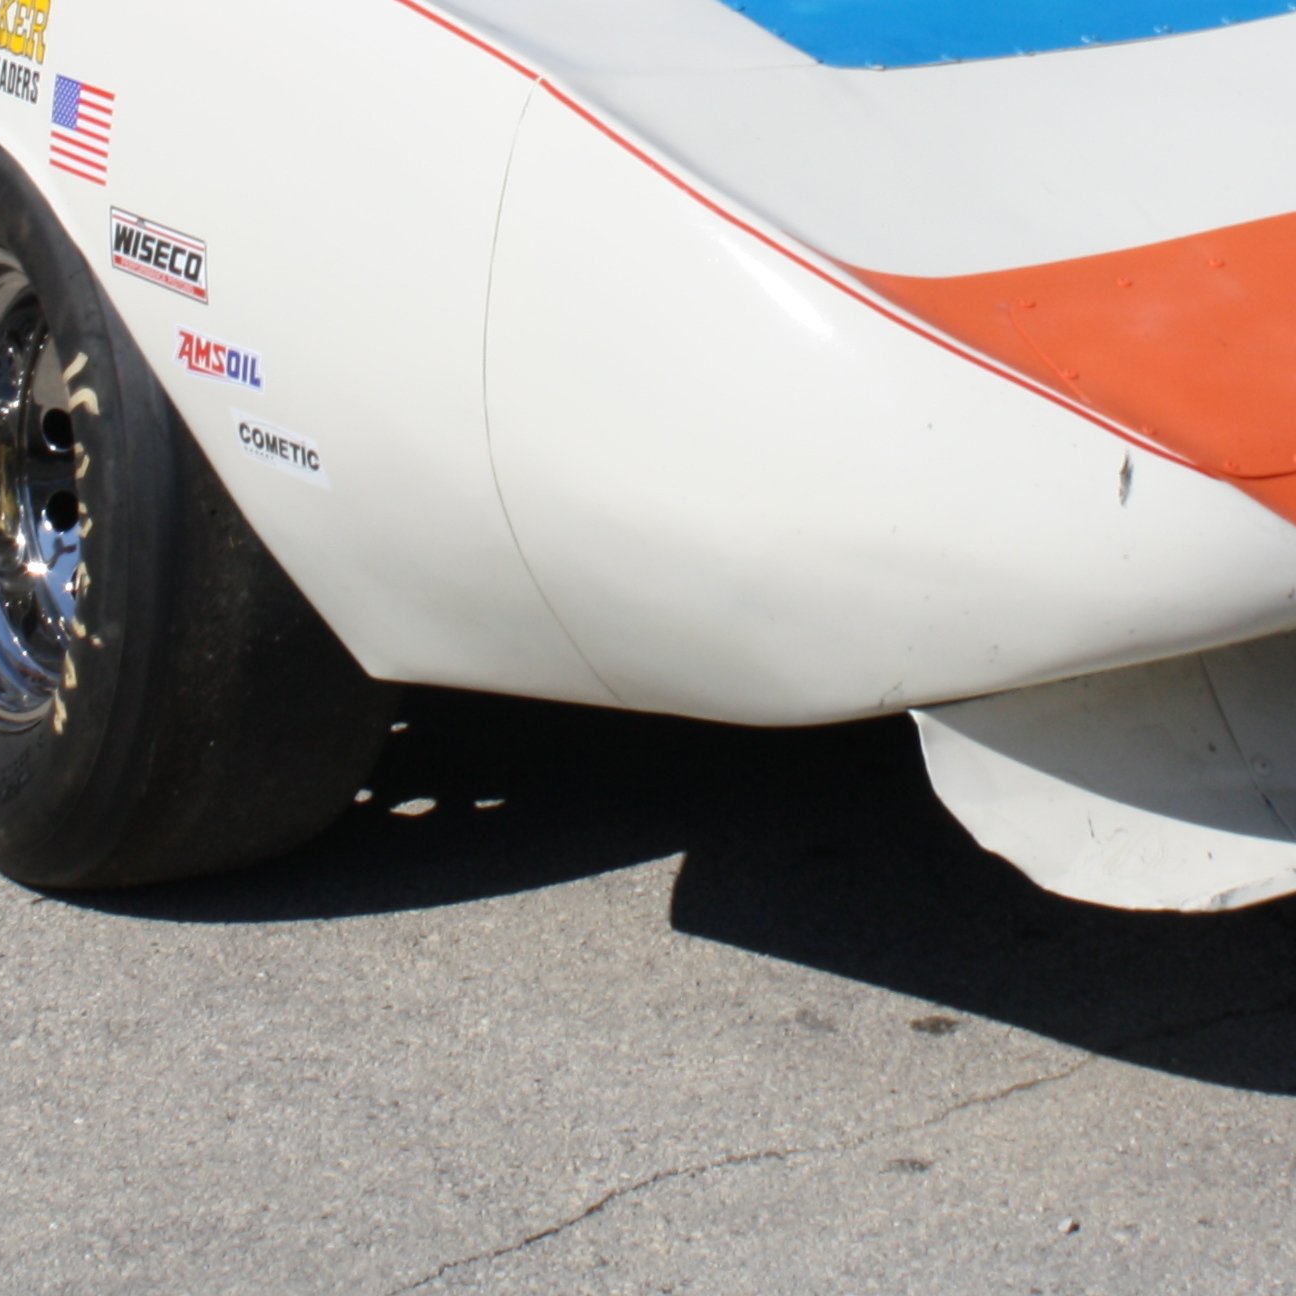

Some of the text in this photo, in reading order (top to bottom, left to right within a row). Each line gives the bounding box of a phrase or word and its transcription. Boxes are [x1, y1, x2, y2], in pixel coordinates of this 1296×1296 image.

[113, 222, 203, 284] WISECO
[178, 330, 261, 388] AMSOIL
[239, 421, 320, 472] COMETIC
